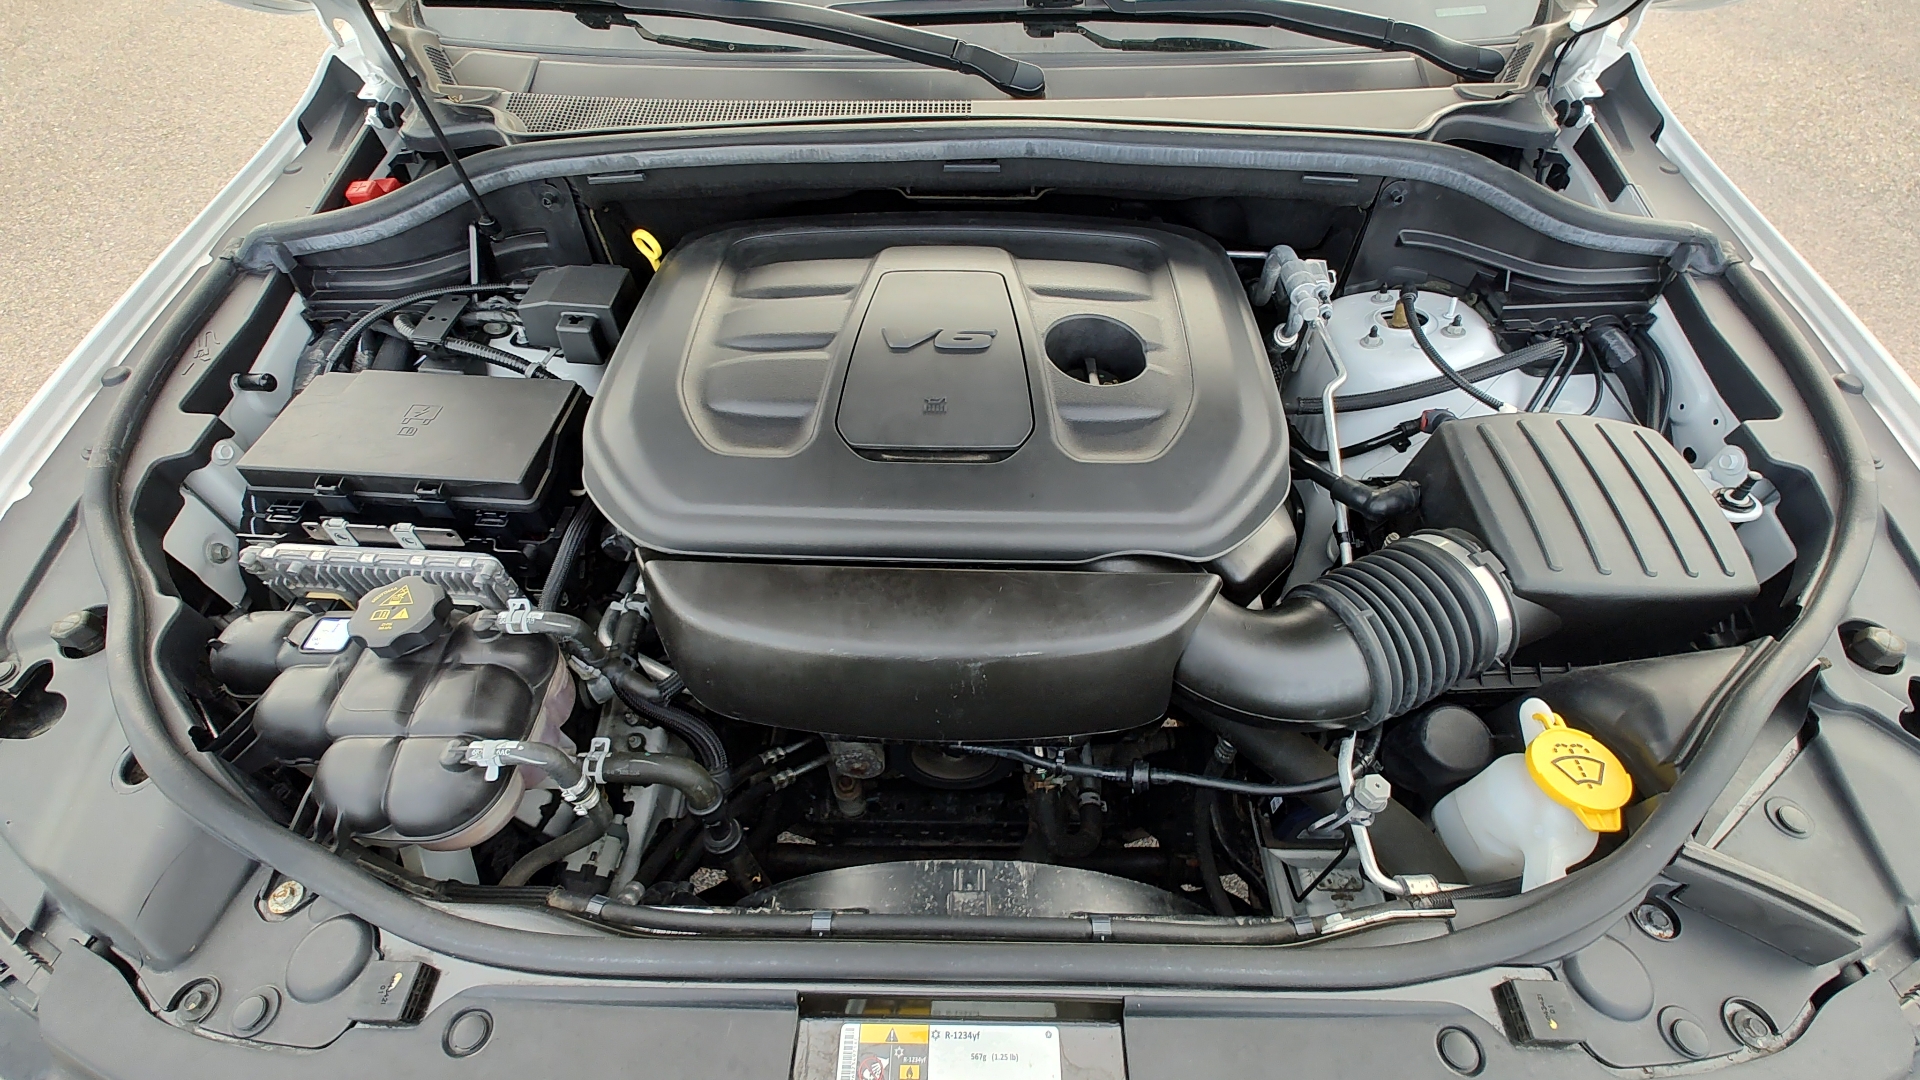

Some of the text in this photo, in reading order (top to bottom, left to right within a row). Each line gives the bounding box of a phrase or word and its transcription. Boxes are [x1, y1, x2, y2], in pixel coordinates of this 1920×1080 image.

[881, 327, 998, 353] V6
[945, 1031, 980, 1041] R-1234yf
[970, 1053, 1019, 1062] 567g (1.25 lb)
